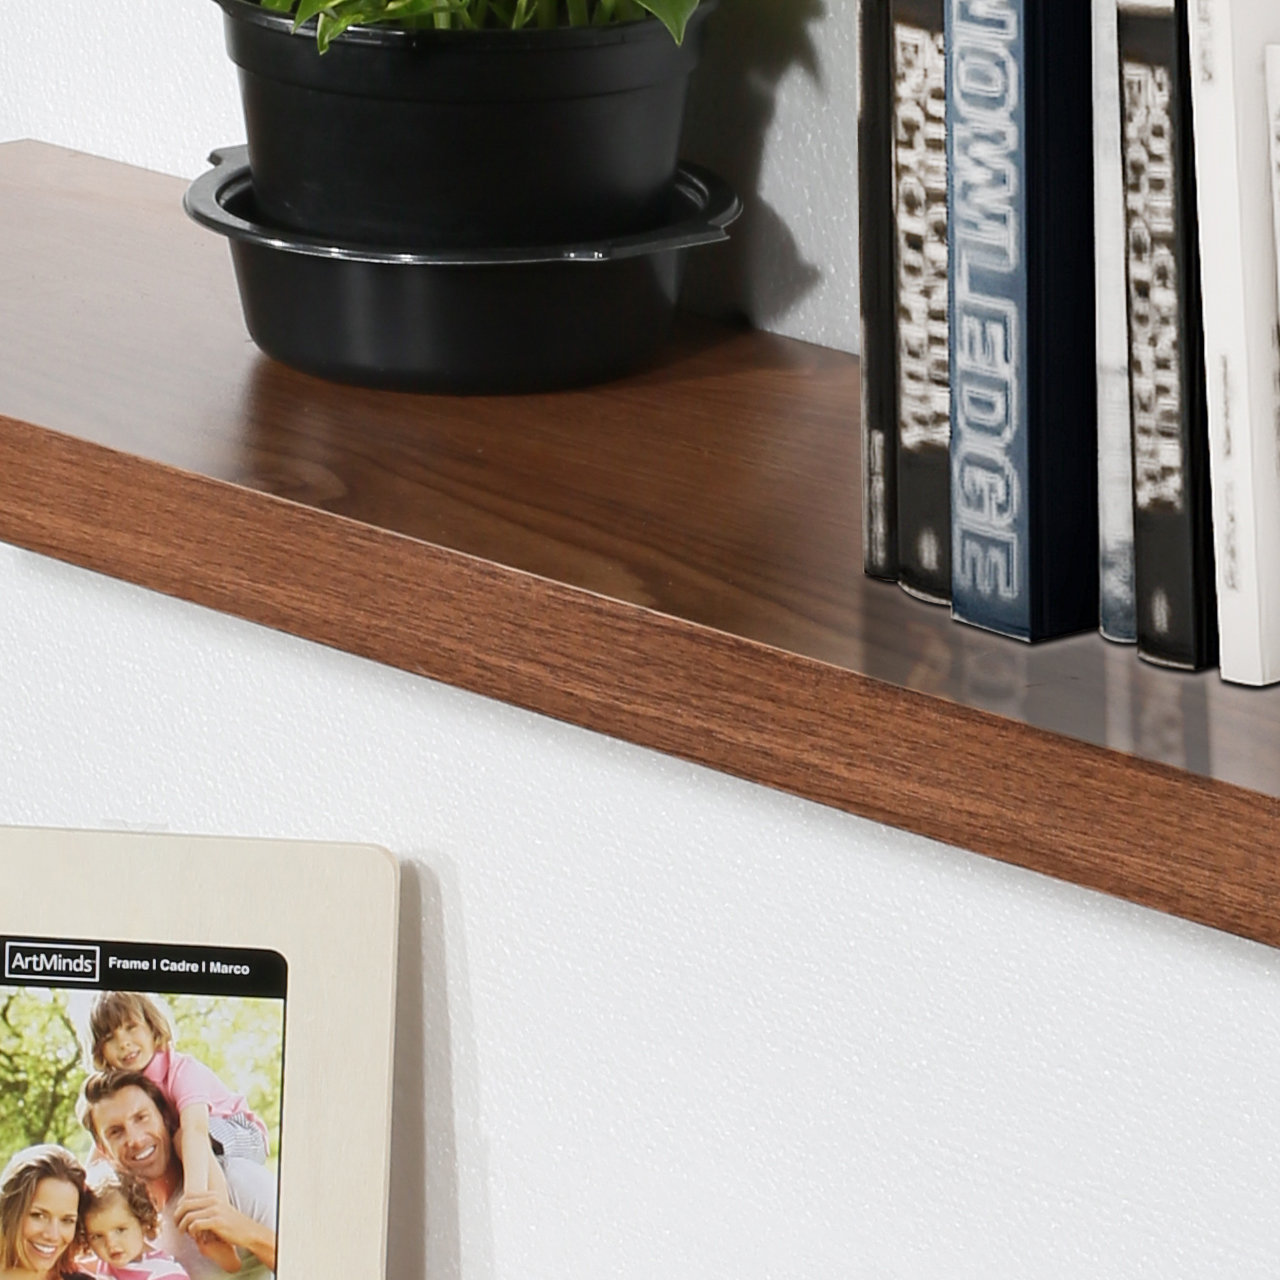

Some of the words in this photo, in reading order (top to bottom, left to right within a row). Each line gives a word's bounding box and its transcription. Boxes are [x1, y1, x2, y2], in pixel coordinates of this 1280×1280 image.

[11, 952, 96, 972] ArtMinds
[108, 956, 150, 970] Frame
[160, 958, 199, 973] Cadre
[209, 961, 250, 975] Marco
